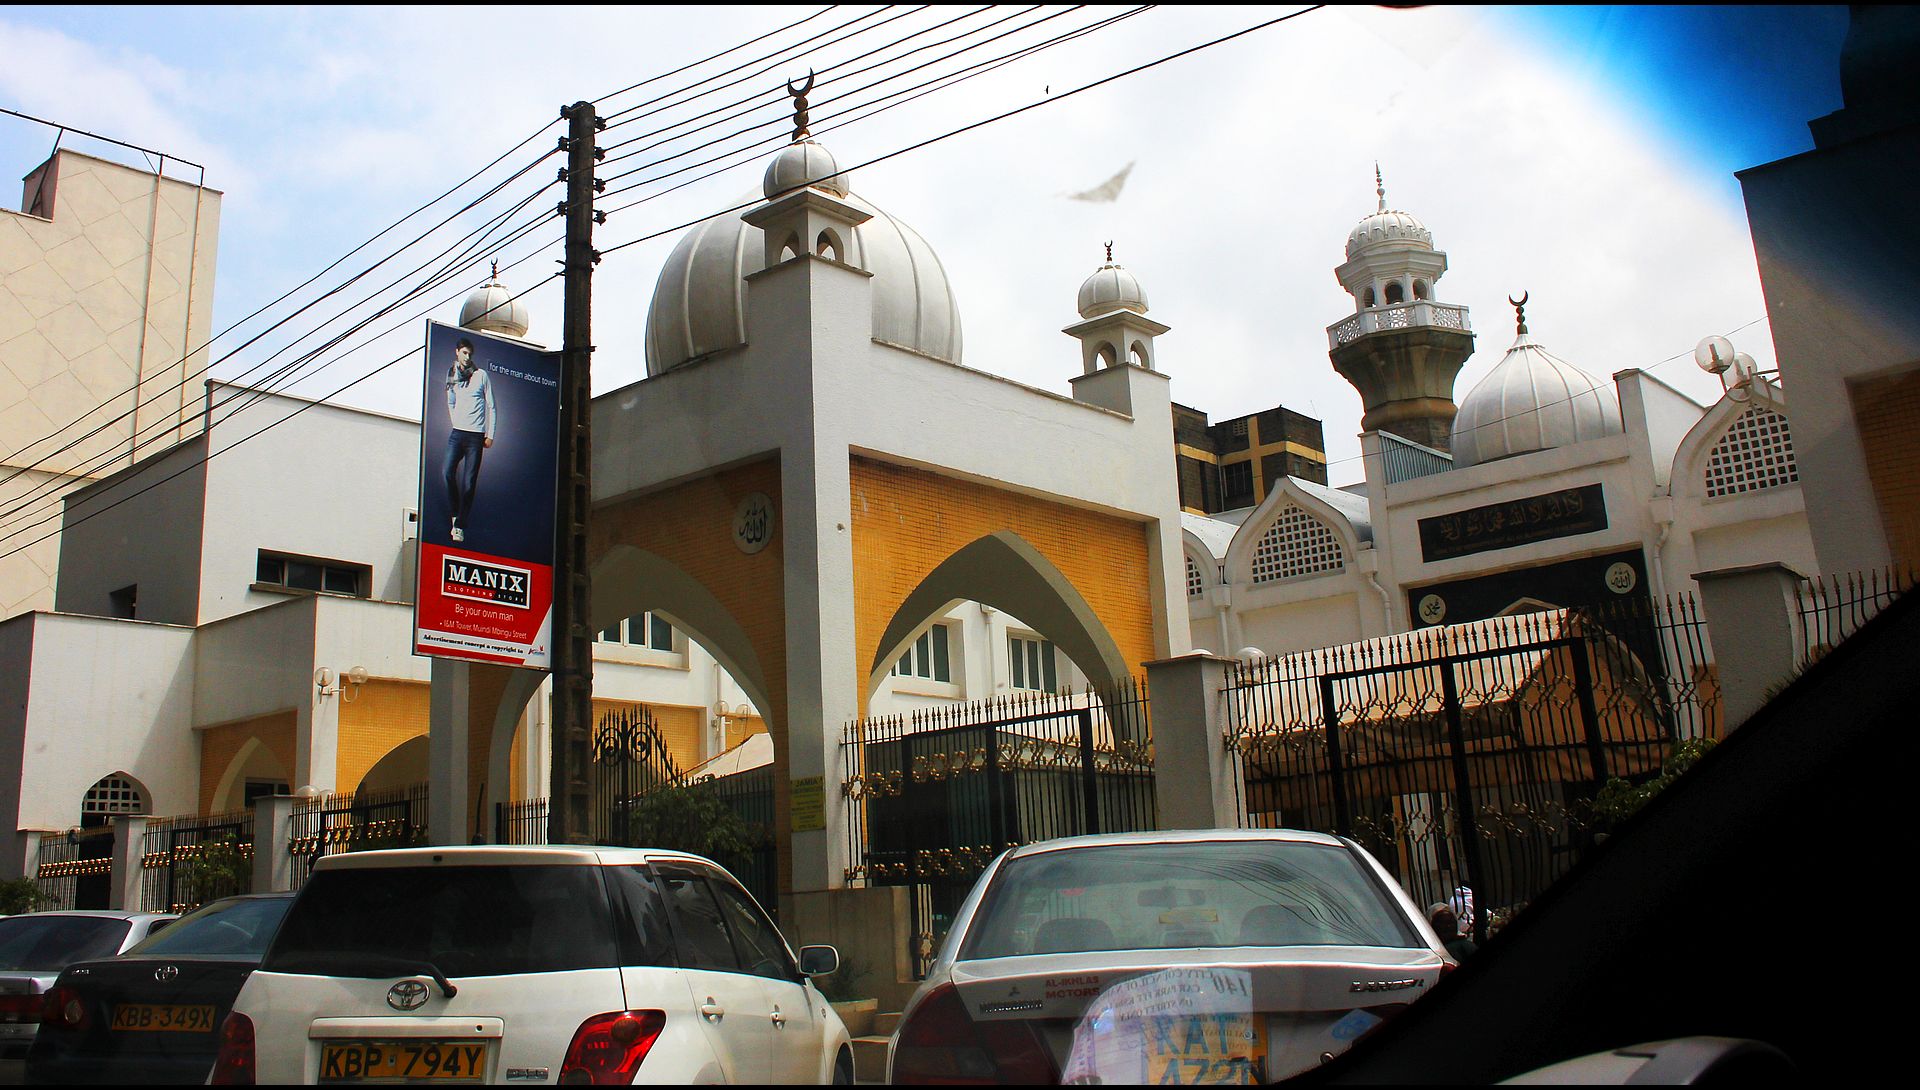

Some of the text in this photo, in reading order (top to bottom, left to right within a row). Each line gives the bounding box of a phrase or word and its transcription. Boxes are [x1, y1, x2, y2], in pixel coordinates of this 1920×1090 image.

[489, 362, 557, 387] for the man about town
[448, 564, 524, 593] MANIX
[1611, 567, 1631, 589] الله
[447, 585, 525, 603] CLOTHING STORE
[455, 603, 514, 622] Be your own man
[423, 634, 464, 645] Advertisement
[464, 640, 485, 649] concept
[491, 644, 516, 654] copyright
[491, 627, 512, 639] Mbingu
[512, 630, 527, 640] Street
[1046, 976, 1099, 988] AL-IKHLAS
[1046, 987, 1100, 999] MOTORS
[114, 1006, 212, 1028] KBB 349X
[1154, 1013, 1229, 1055] KAT
[325, 1046, 383, 1078] KBP
[404, 1045, 482, 1077] 794Y
